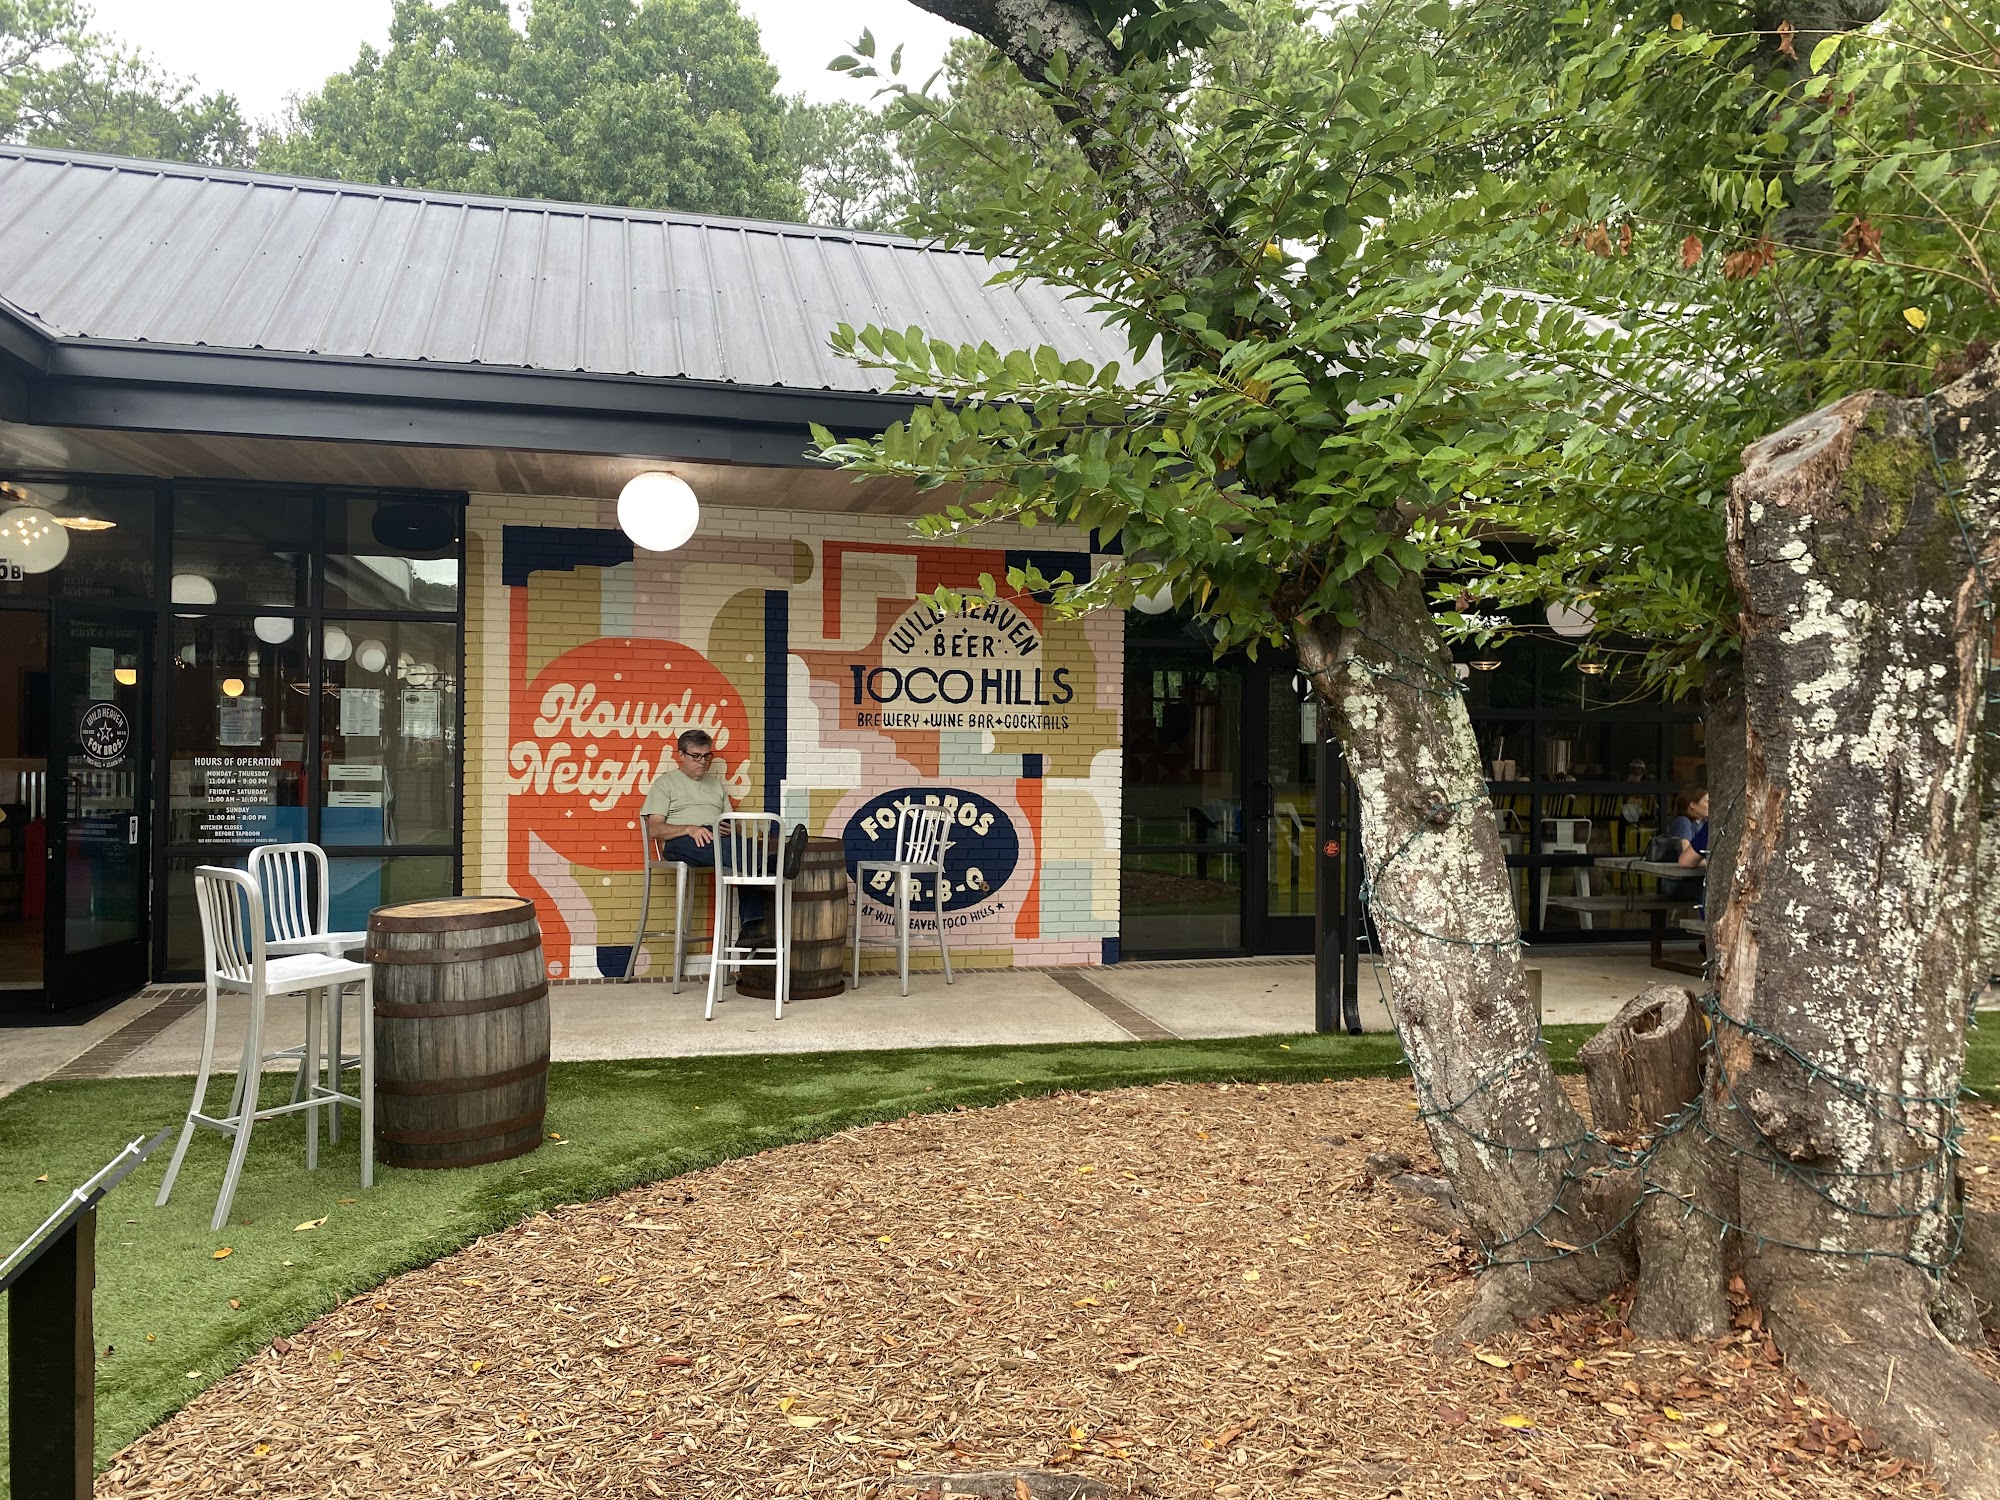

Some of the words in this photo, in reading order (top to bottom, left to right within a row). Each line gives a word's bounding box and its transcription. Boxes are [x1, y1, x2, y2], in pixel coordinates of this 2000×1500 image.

[934, 634, 995, 658] BEER
[850, 665, 974, 705] TOCO
[981, 667, 1074, 706] HILLS
[86, 708, 102, 727] WILD
[102, 707, 124, 728] HEAVEN
[857, 712, 920, 728] BREWERY
[931, 713, 964, 728] WINE
[969, 713, 999, 729] BAR
[1004, 714, 1070, 730] COCKTAILS
[87, 736, 103, 755] FOX
[194, 757, 222, 766] HOURS
[224, 757, 235, 766] OF
[236, 757, 282, 766] OPERATION
[925, 794, 995, 837] BROS
[861, 904, 875, 916] AT
[942, 915, 967, 930] TOCO
[970, 905, 995, 922] HILLS
